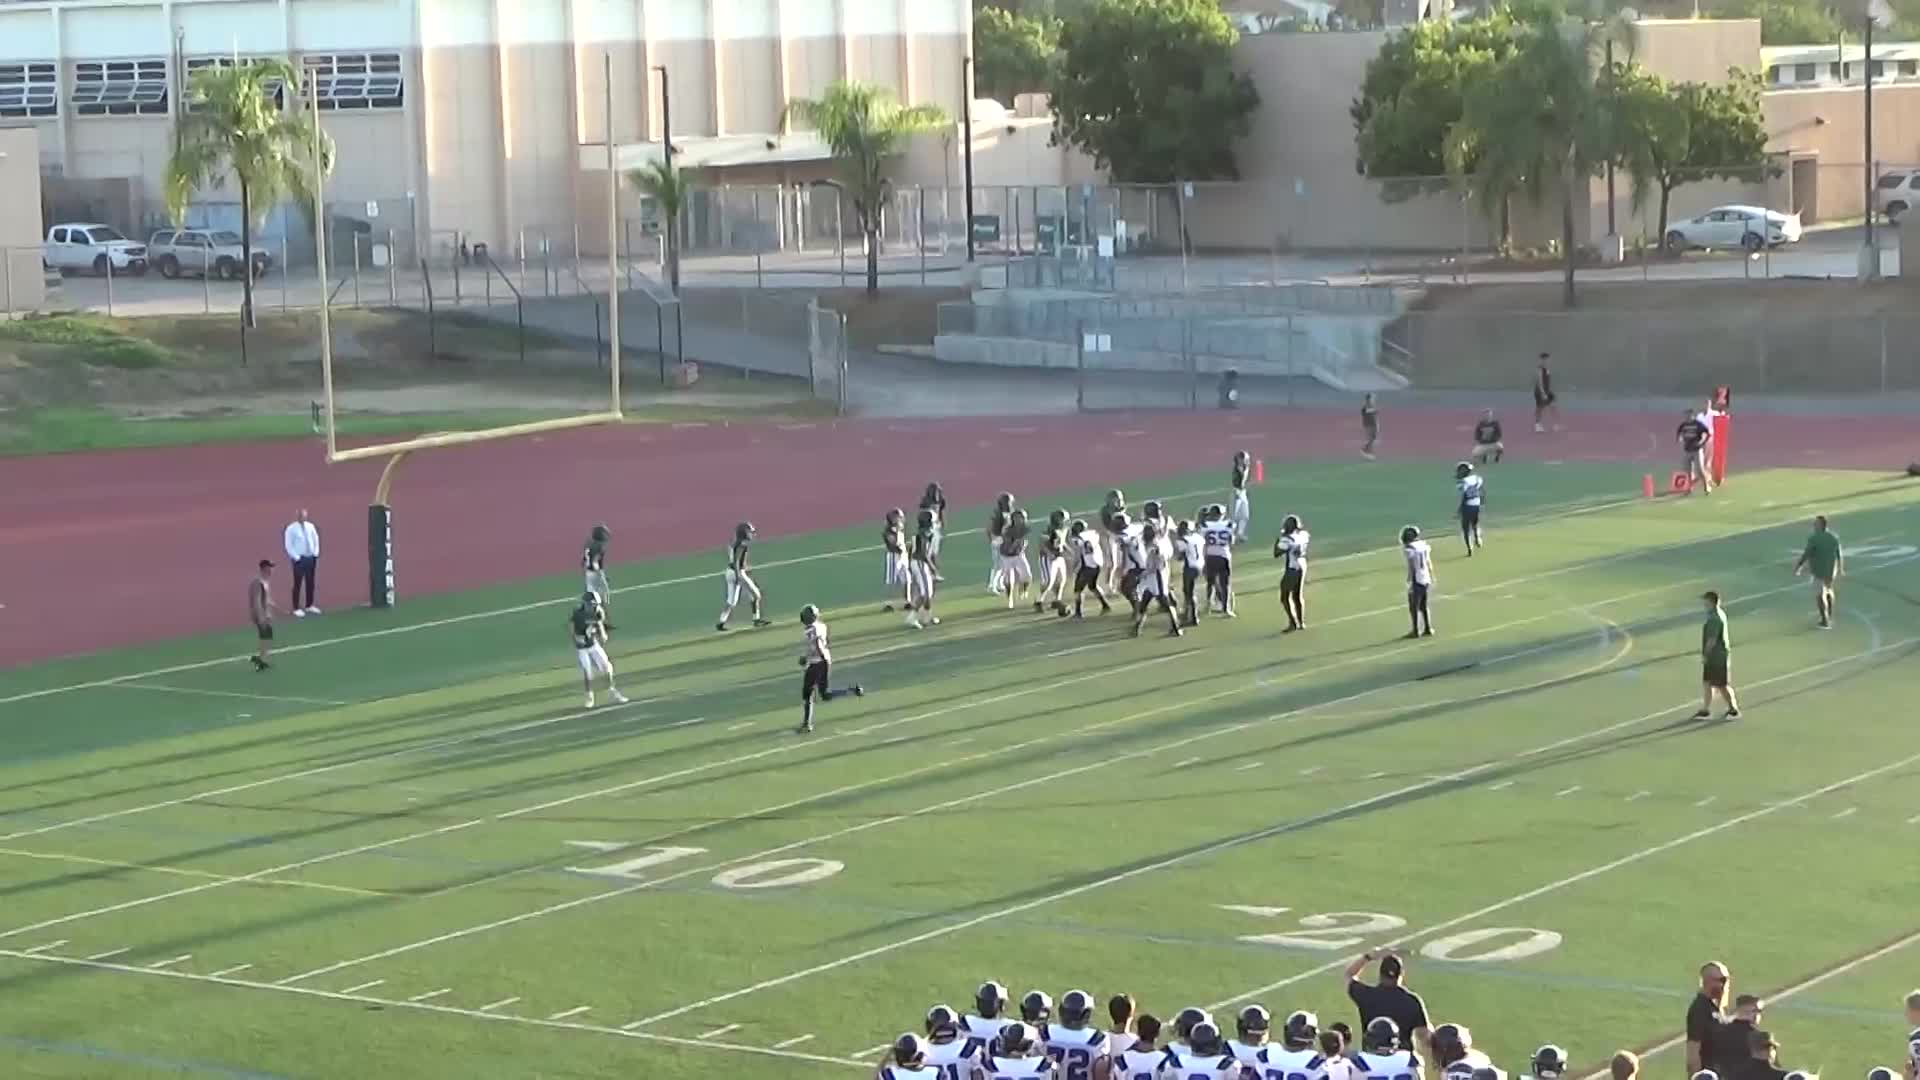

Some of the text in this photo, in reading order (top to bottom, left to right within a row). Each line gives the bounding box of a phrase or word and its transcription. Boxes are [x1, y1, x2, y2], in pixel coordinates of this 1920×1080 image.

[385, 510, 394, 607] TITANS
[562, 846, 846, 889] 10
[1234, 911, 1563, 962] 20
[1047, 1047, 1090, 1080] 72
